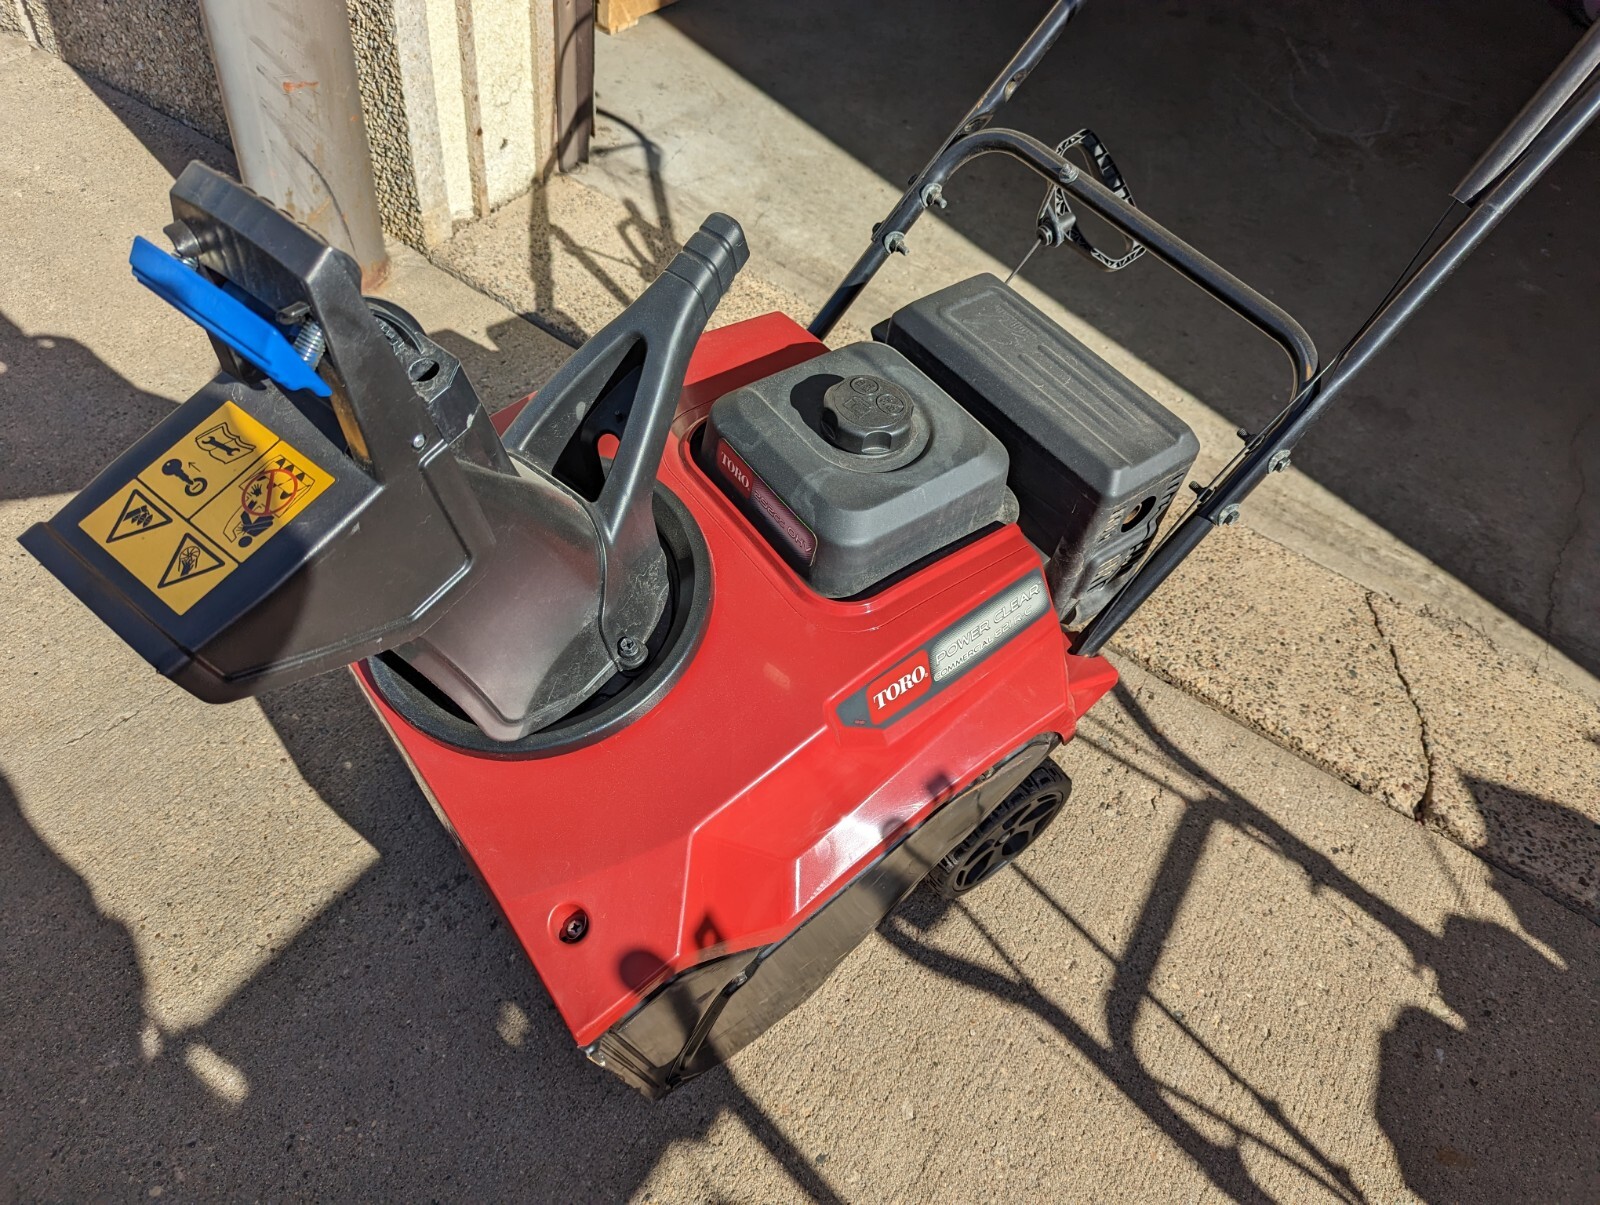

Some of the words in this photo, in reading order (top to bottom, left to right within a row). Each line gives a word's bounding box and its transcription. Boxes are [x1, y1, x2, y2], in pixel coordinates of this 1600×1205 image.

[721, 451, 750, 489] TORO
[786, 525, 812, 552] OHV
[935, 619, 990, 666] POWER
[993, 583, 1040, 624] CLEAR
[933, 637, 992, 682] COMMERCIAL
[873, 664, 928, 710] TORO
